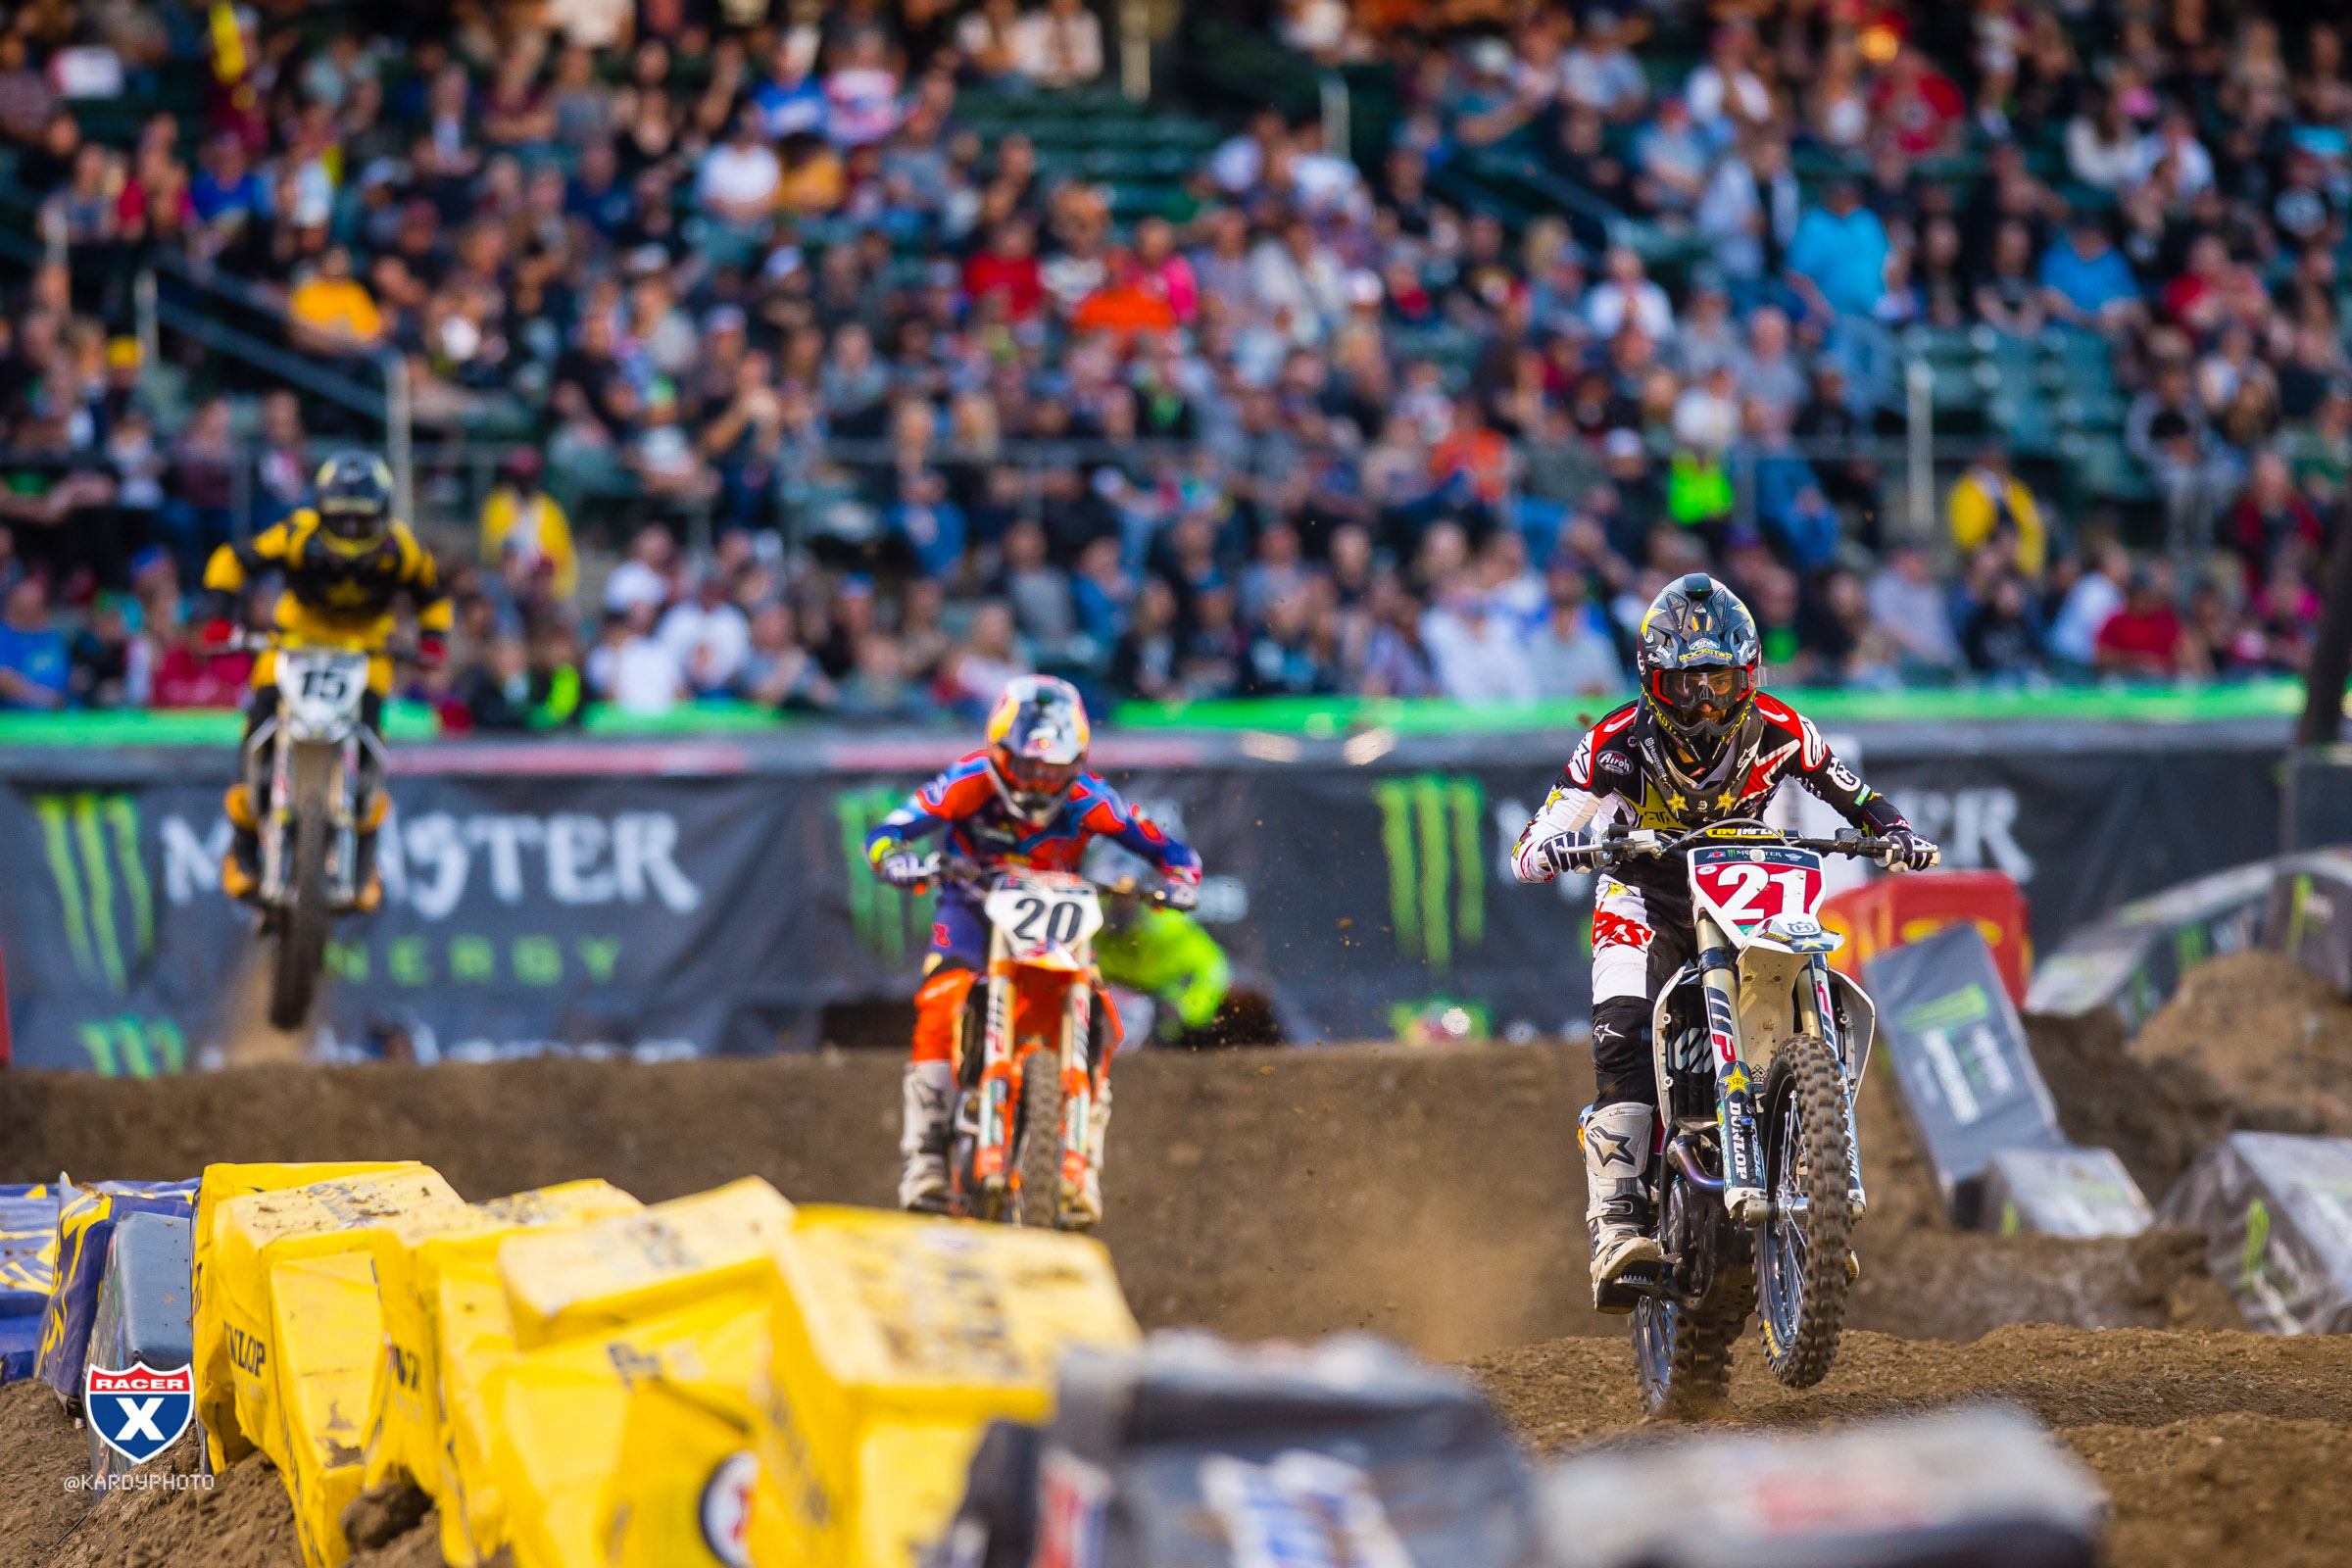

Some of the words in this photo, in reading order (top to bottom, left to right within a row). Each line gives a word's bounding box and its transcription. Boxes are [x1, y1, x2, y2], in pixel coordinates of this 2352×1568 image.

[302, 665, 345, 700] 15
[1599, 753, 1630, 772] Airoh
[1717, 863, 1807, 919] 21
[1013, 898, 1083, 943] 20
[323, 934, 622, 985] NERGY
[1729, 1101, 1748, 1180] DUNLOP
[1763, 1318, 1782, 1358] DUNLOP
